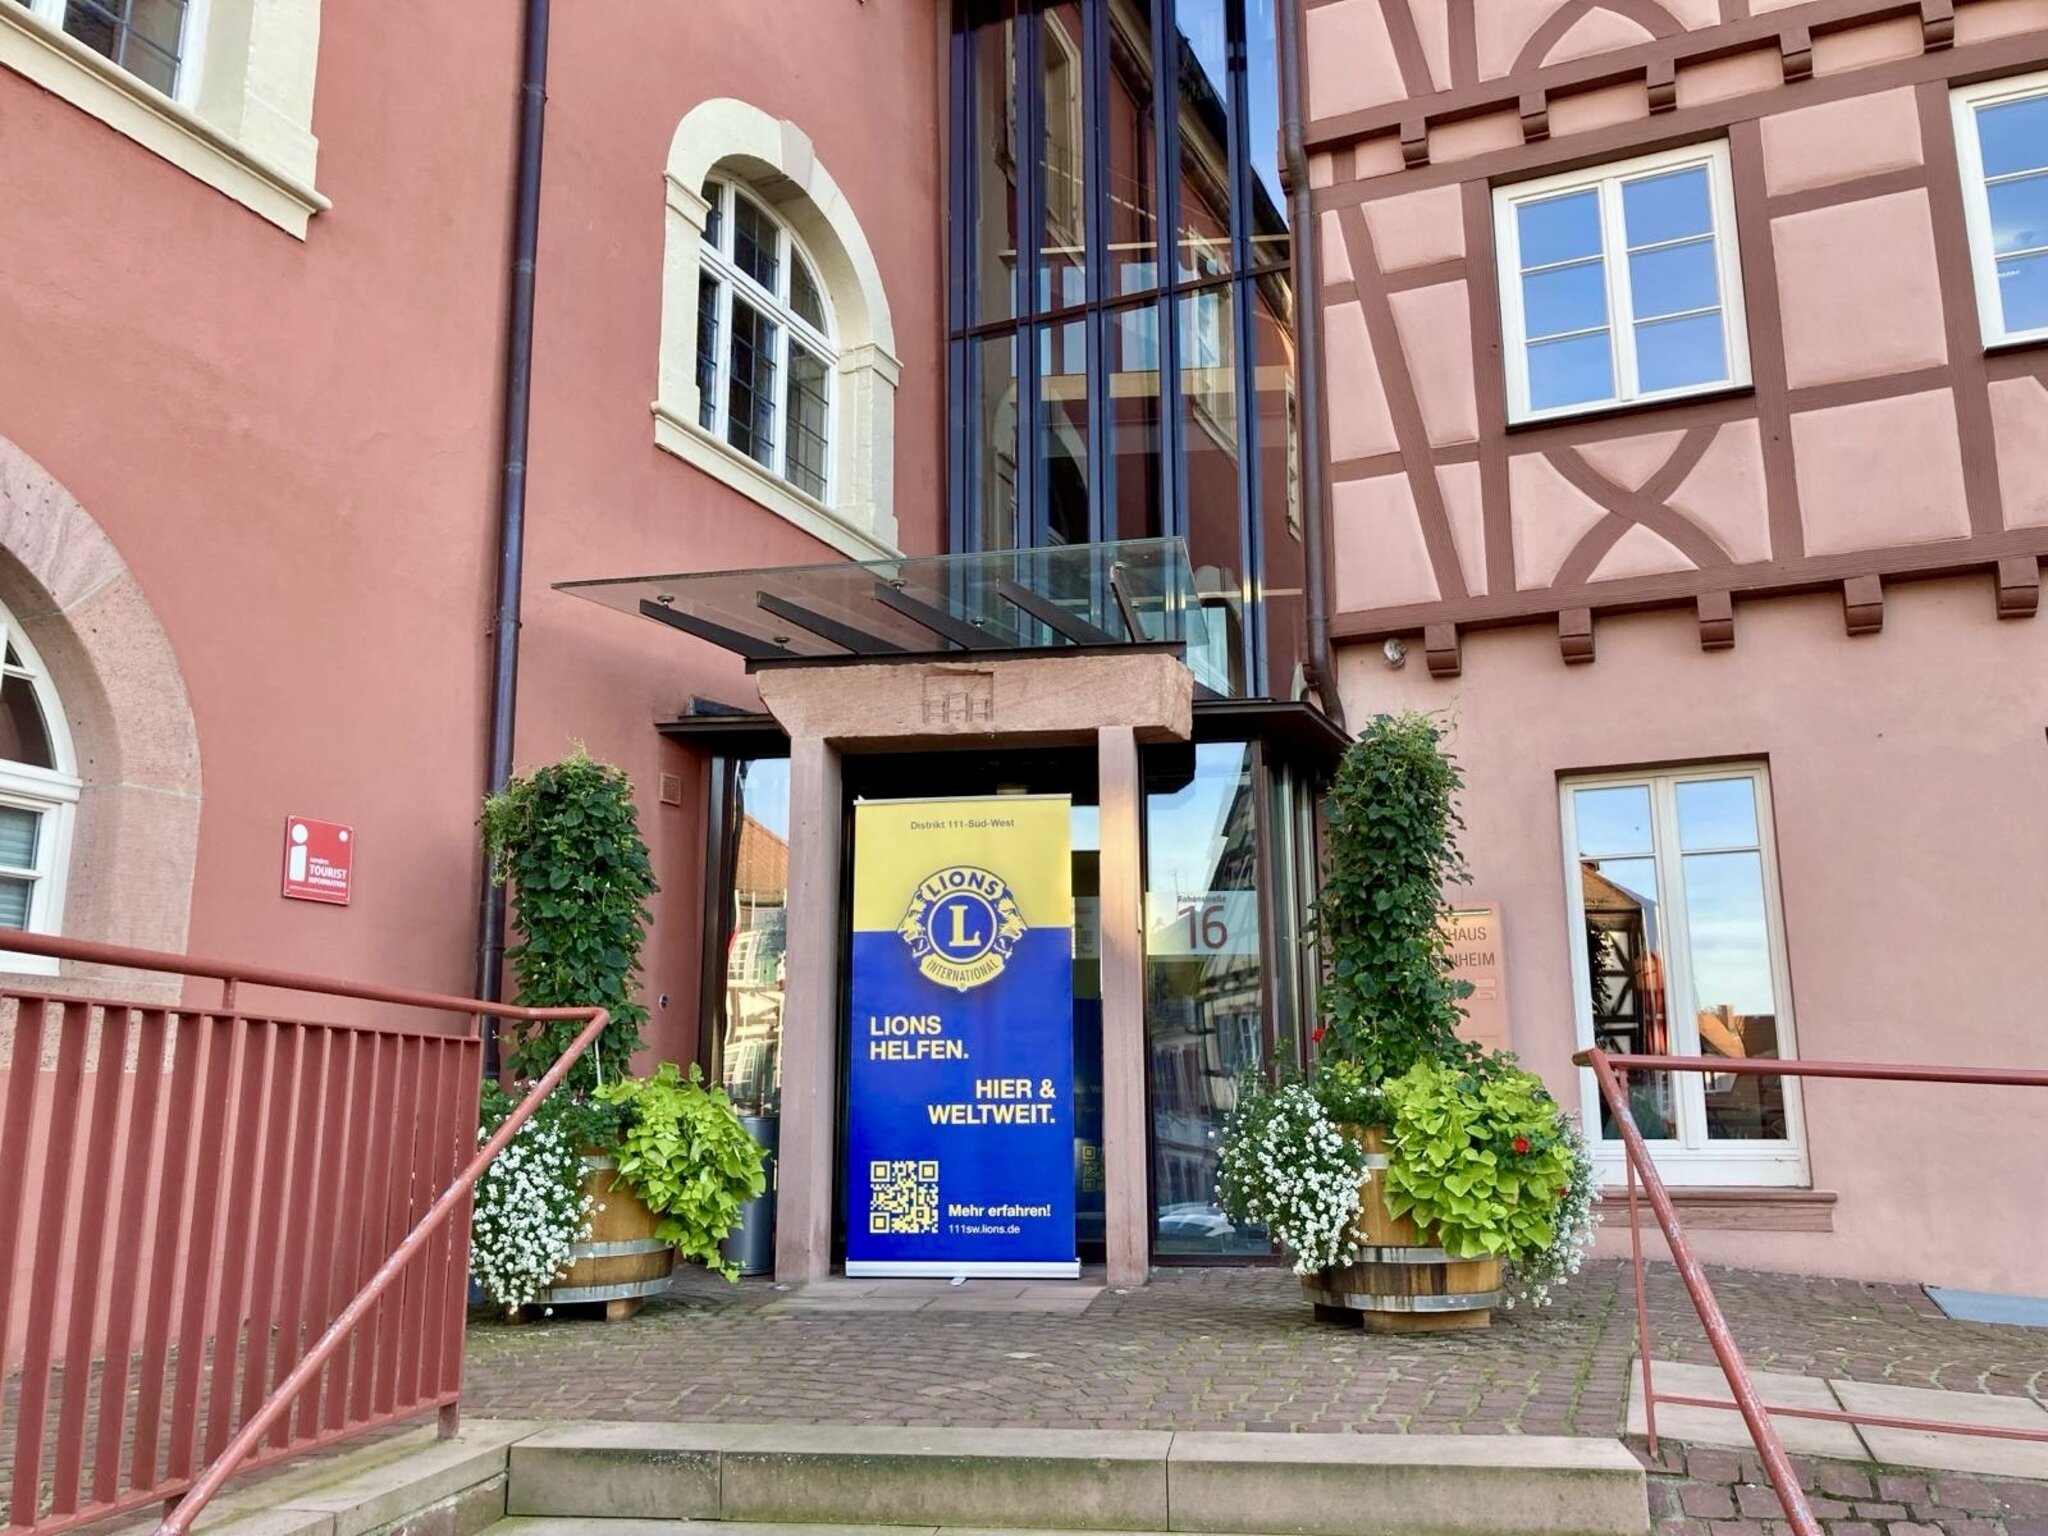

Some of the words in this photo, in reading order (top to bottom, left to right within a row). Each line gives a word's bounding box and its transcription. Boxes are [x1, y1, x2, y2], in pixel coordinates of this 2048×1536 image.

[910, 820, 945, 830] Distrikt
[949, 818, 1015, 829] 111-Süd-West
[309, 863, 348, 880] TOURIST
[925, 871, 999, 897] LIONS
[949, 904, 981, 947] L
[1178, 905, 1228, 949] 16
[925, 959, 999, 982] INTERNATIONAL
[869, 1015, 942, 1036] LIONS
[869, 1039, 969, 1060] HELFEN.
[976, 1079, 1032, 1099] HIER
[1039, 1078, 1056, 1099] &
[927, 1103, 1056, 1125] WELTWEIT.
[948, 1204, 986, 1217] Mehr
[988, 1203, 1051, 1217] erfahren!
[948, 1224, 1021, 1234] 111sw.lions.de
